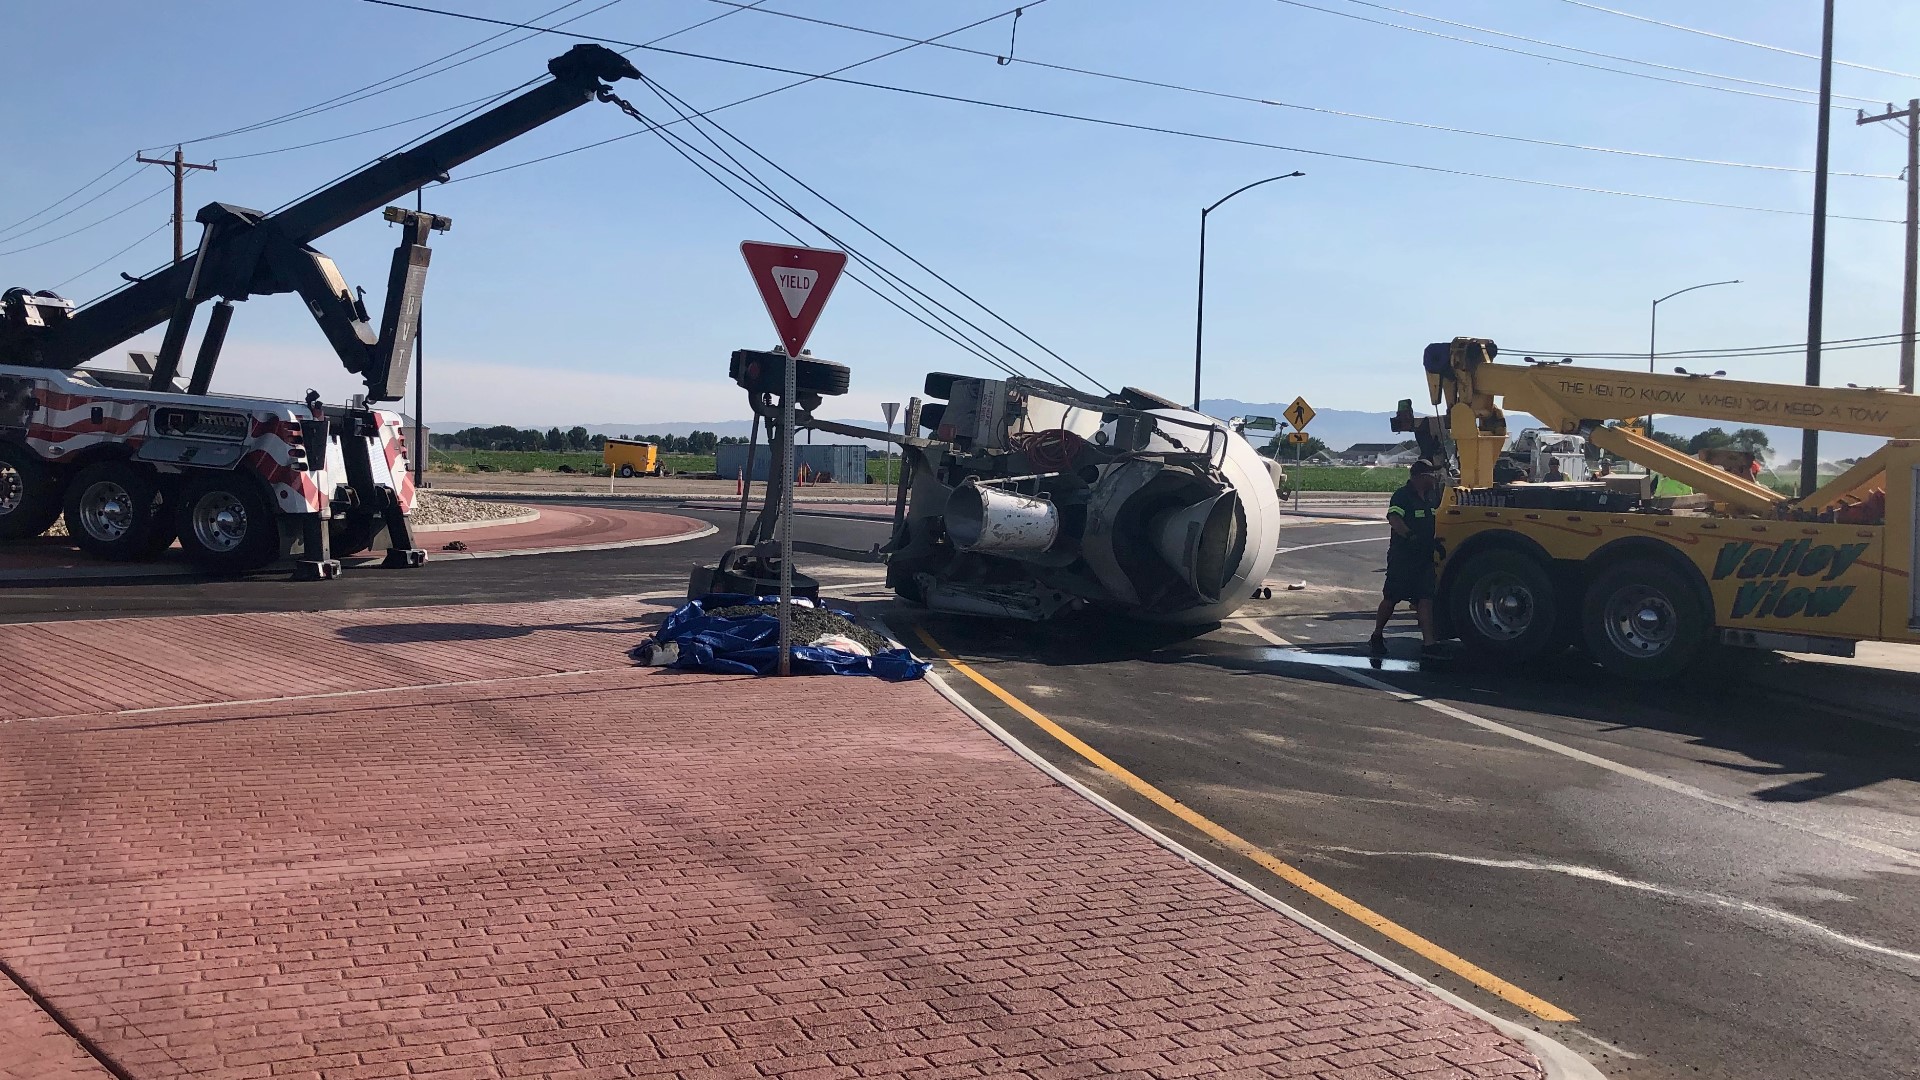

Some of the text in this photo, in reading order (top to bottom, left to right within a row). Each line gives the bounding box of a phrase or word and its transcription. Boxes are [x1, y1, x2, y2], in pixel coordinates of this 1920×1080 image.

[779, 274, 810, 290] YIELD
[1558, 381, 1585, 395] THE
[1588, 383, 1613, 397] MEN
[1616, 386, 1636, 399] TO
[1698, 393, 1743, 409] WHEN
[1747, 397, 1778, 413] YOU
[1783, 402, 1824, 417] NEED
[1829, 406, 1841, 419] A
[1848, 406, 1889, 423] TOW
[1711, 538, 1870, 581] Valley
[1729, 580, 1857, 619] View
